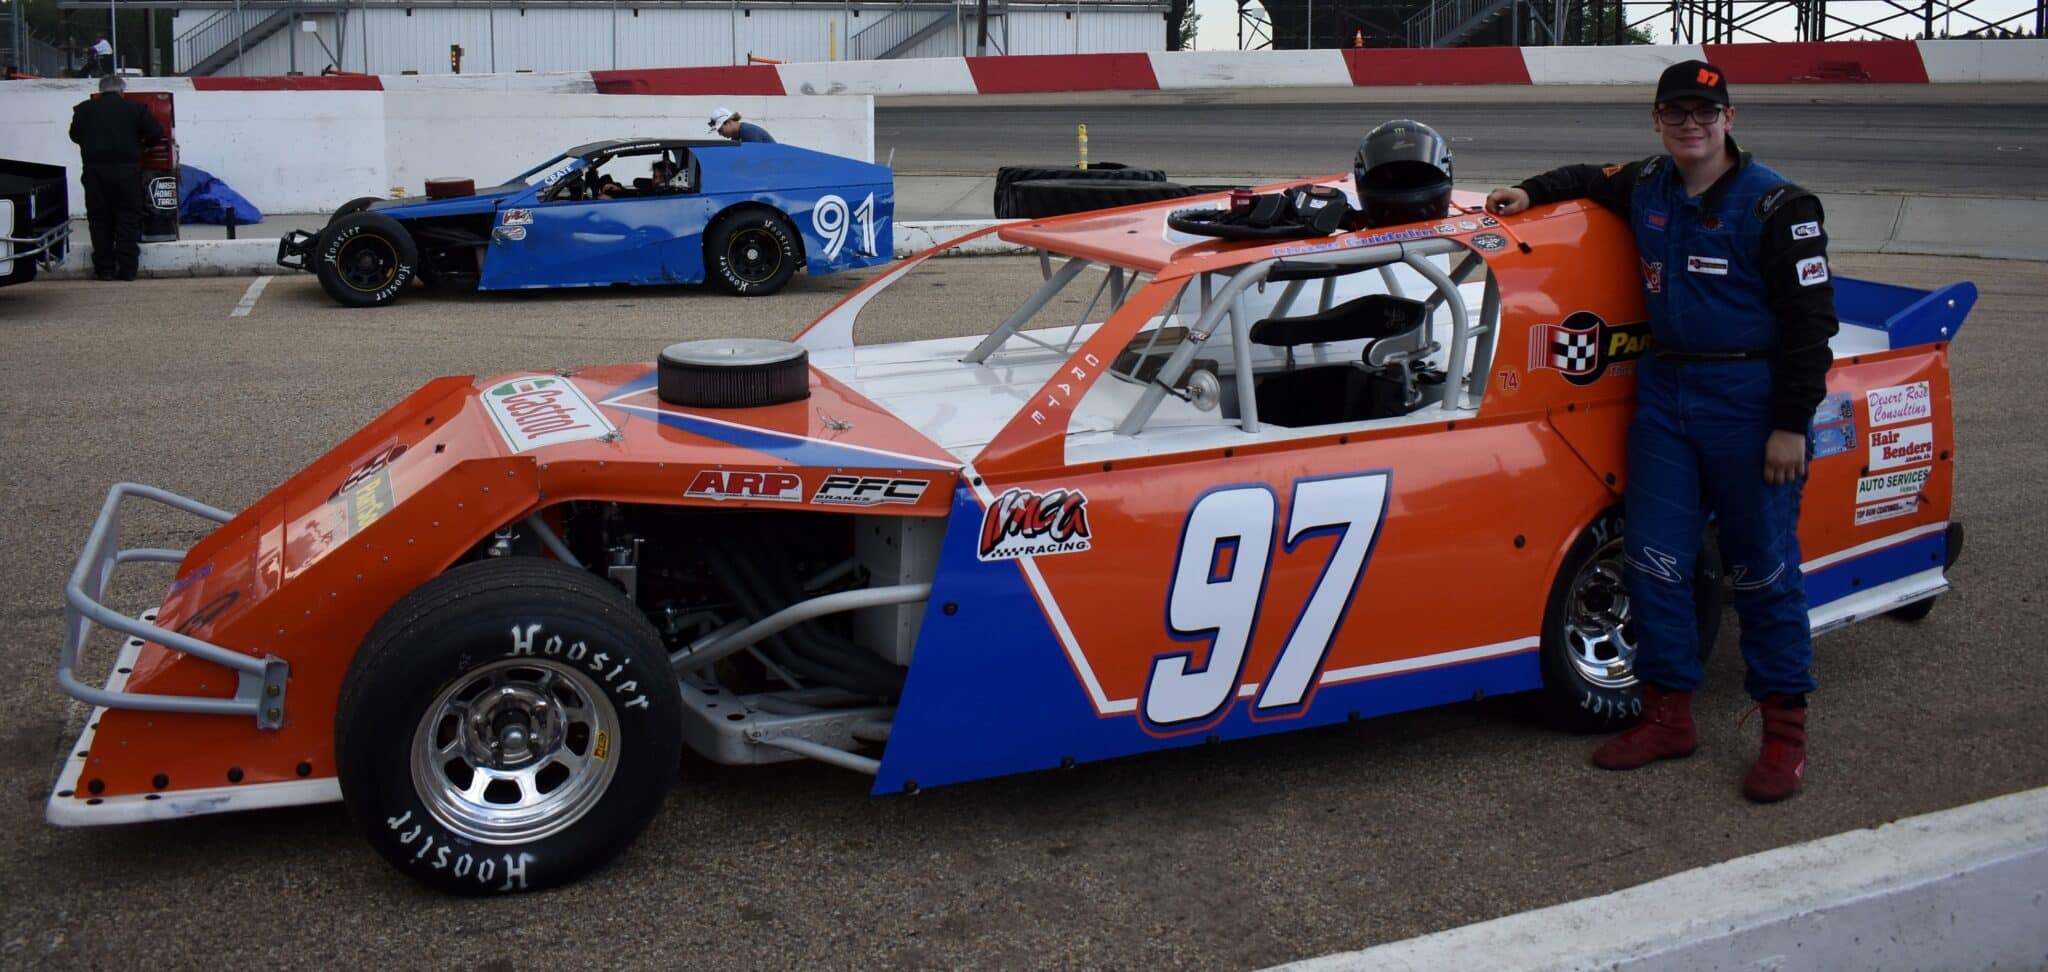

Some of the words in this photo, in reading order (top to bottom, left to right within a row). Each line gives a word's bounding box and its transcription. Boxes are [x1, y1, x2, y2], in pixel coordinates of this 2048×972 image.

[544, 163, 575, 185] CRATE
[812, 191, 879, 263] 91
[323, 226, 360, 267] Hoosier
[375, 263, 412, 301] Hoosier
[1031, 353, 1100, 425] CRATE
[1500, 372, 1518, 391] 74
[1869, 391, 1902, 407] Desert
[1905, 385, 1929, 400] Rose
[501, 389, 592, 440] Castrol
[1874, 402, 1926, 422] Consulting
[1871, 431, 1900, 447] Hair
[1883, 441, 1932, 460] Benders
[688, 471, 801, 495] ARP
[819, 476, 929, 498] PFC
[1859, 479, 1884, 493] AUTO
[1886, 469, 1929, 488] SERVICES
[816, 494, 870, 502] BRAKES
[1024, 541, 1086, 555] RACING
[1144, 469, 1391, 729] 97
[504, 623, 649, 709] Hoosier
[387, 810, 539, 892] Hoosier
